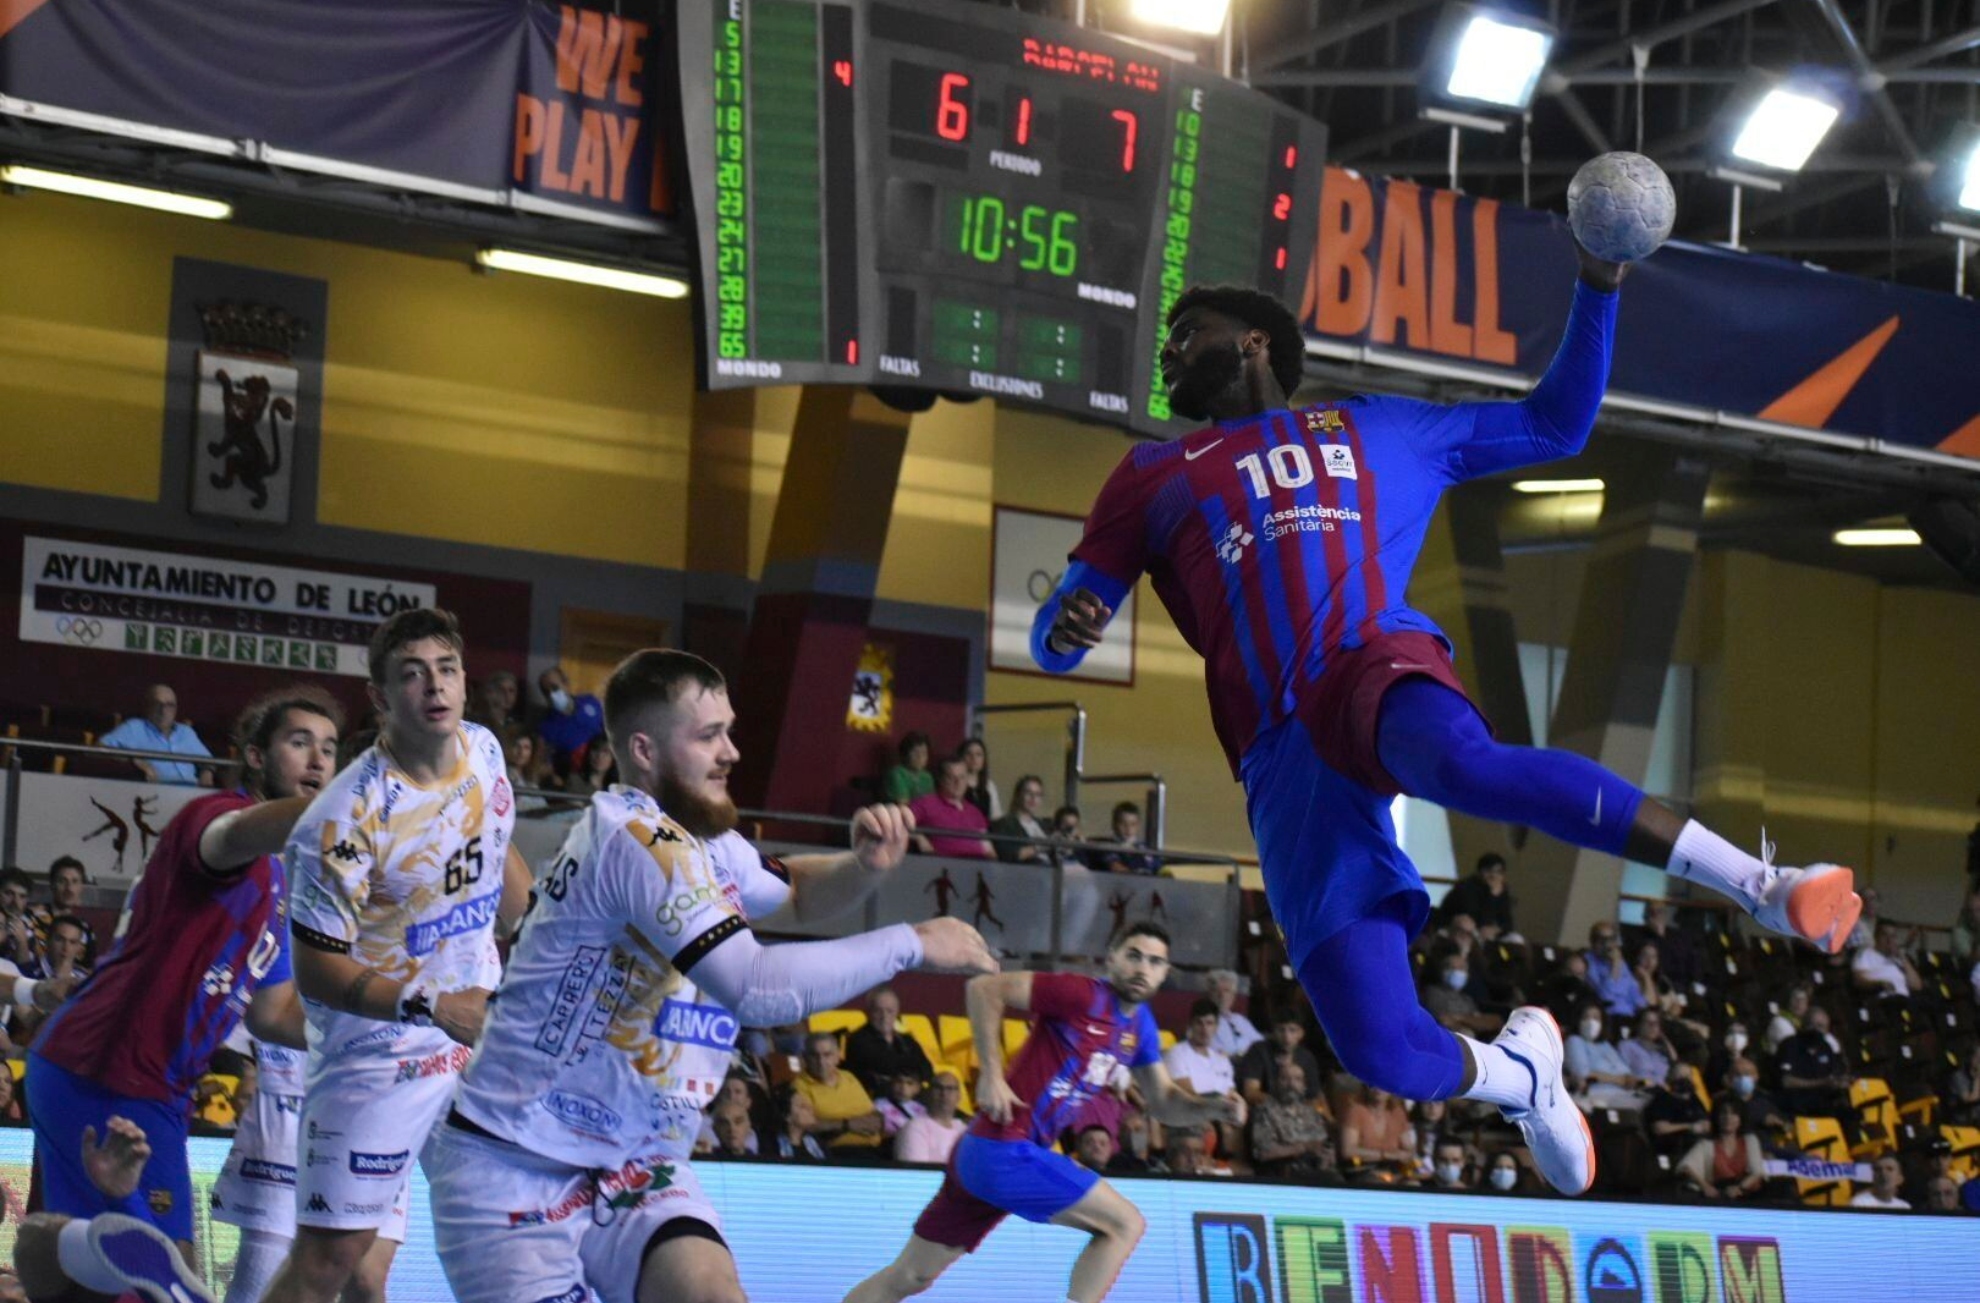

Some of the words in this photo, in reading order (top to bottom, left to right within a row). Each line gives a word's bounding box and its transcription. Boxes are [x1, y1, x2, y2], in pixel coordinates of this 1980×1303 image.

[556, 4, 649, 107] WE
[834, 61, 851, 86] 4
[936, 72, 969, 142] 6
[1015, 97, 1031, 145] 1
[514, 92, 640, 203] PLAY
[1110, 108, 1138, 173] 7
[989, 151, 1042, 177] PERIODO
[1286, 145, 1297, 169] 1
[1273, 193, 1293, 220] 2
[960, 197, 1079, 276] 10:56
[1276, 246, 1287, 270] 1
[1299, 165, 1517, 366] BALL
[1077, 282, 1137, 309] MONDO
[847, 340, 858, 364] 1
[717, 359, 783, 379] MONDO
[879, 355, 921, 378] FALTAS
[1235, 444, 1315, 499] 10
[1262, 504, 1361, 528] Assistència
[1264, 517, 1335, 541] Sanitària
[42, 552, 276, 605] AYUNTAMIENTO
[295, 583, 331, 611] DE
[348, 582, 420, 618] LEÓN
[444, 836, 483, 896] 65
